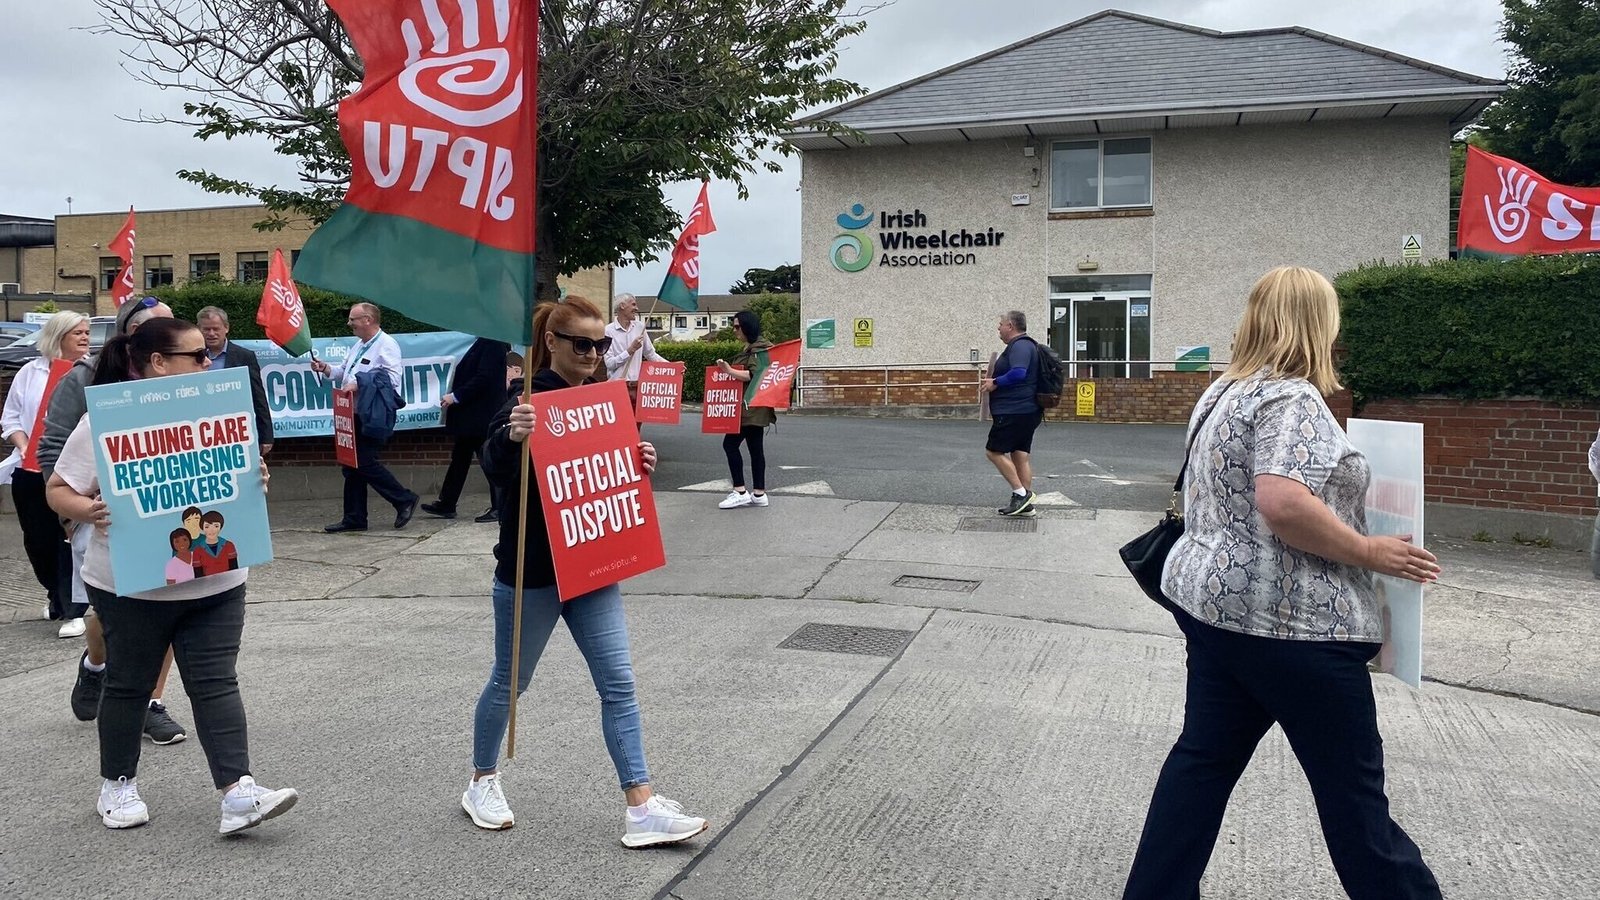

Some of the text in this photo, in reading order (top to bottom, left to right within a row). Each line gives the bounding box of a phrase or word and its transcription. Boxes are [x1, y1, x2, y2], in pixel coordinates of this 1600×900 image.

[880, 209, 927, 229] Irish
[879, 227, 1005, 250] Wheelchair
[879, 251, 976, 267] Association
[654, 367, 676, 376] SIPTU
[215, 381, 242, 393] SIPTU
[266, 362, 452, 412] COMITY
[640, 381, 678, 396] OFFICIAL
[706, 389, 739, 403] OFFICIAL
[641, 395, 675, 409] DISPUTE
[707, 404, 737, 418] DISPUTE
[273, 419, 326, 431] OMMUNITY
[566, 401, 616, 432] SIPTU
[105, 416, 249, 463] VALUING CARE
[113, 444, 246, 491] RECOGNISING
[545, 446, 642, 504] OFFICIAL
[136, 472, 234, 514] WORKERS
[559, 488, 646, 548] DISPUTE
[588, 555, 638, 578] www.siptu.ie
